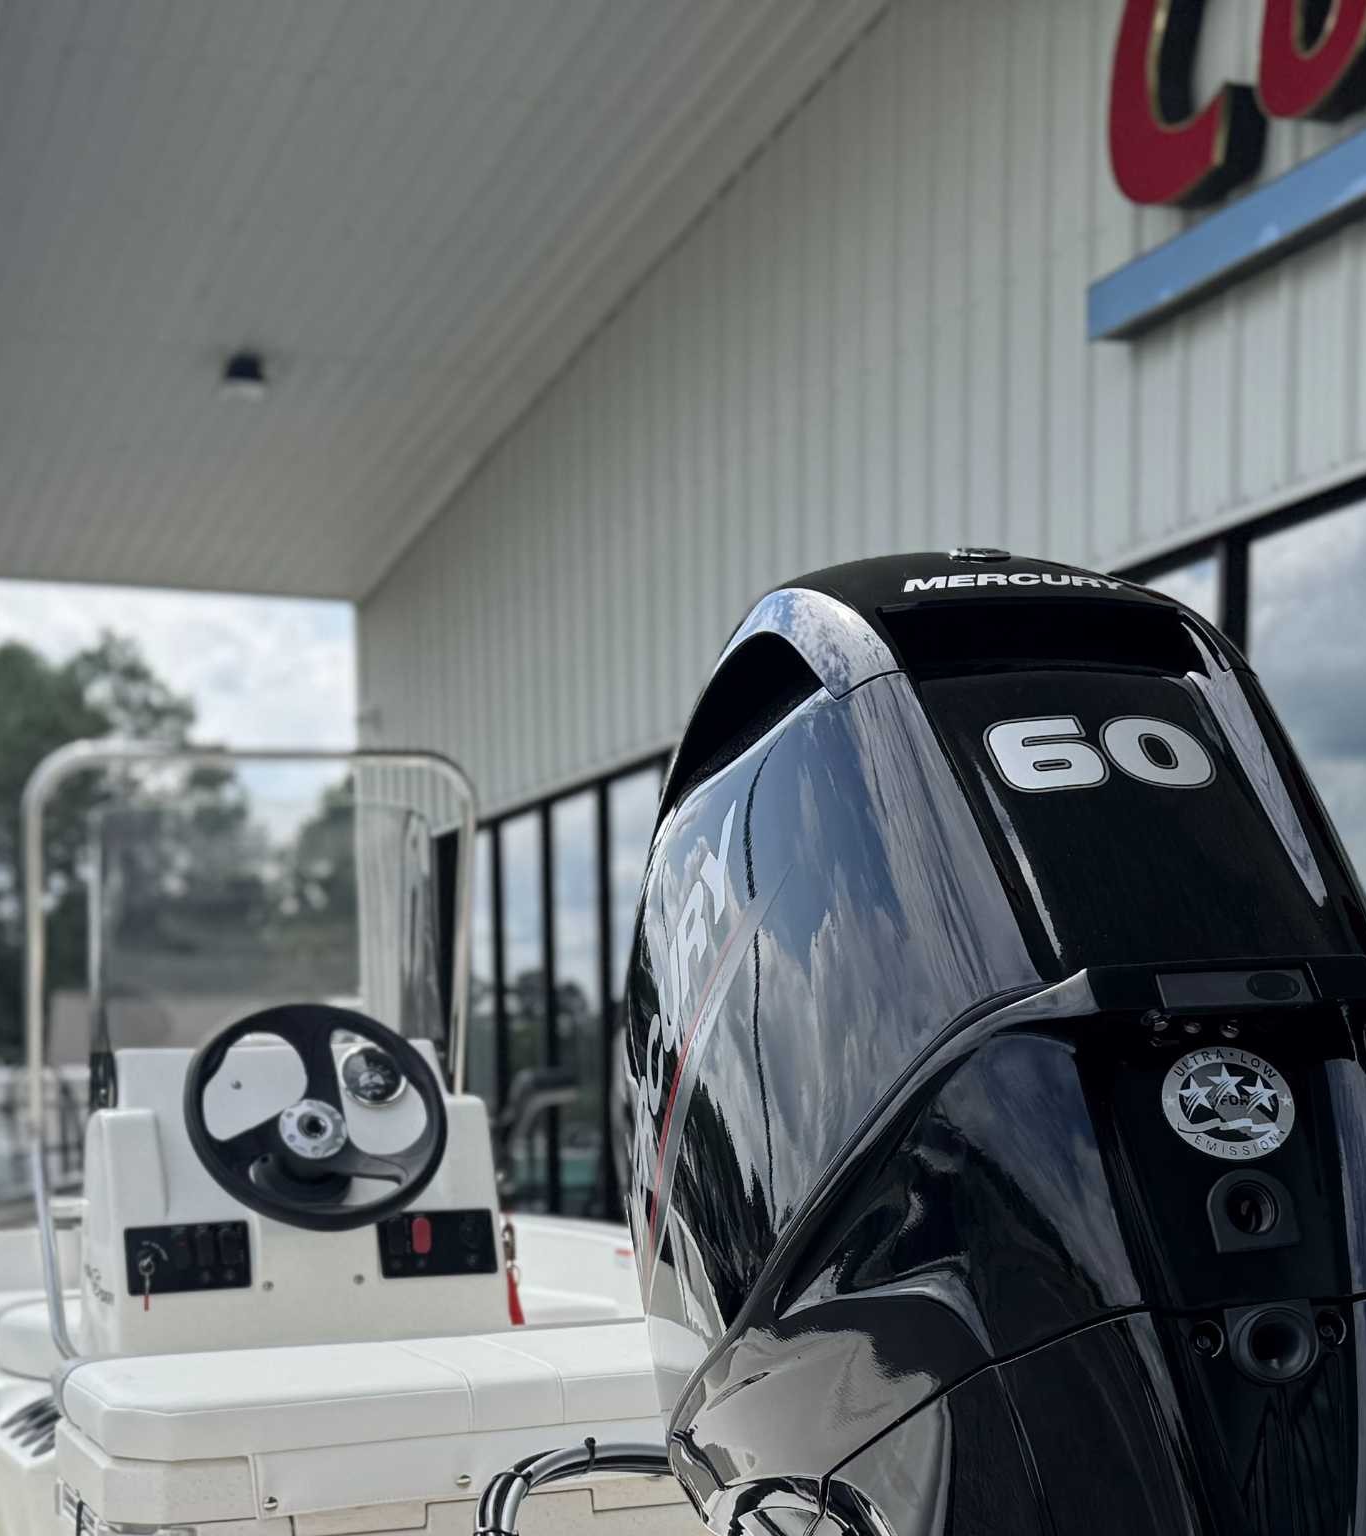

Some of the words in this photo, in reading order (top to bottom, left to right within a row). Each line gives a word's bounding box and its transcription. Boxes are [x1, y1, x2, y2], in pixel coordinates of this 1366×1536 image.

[903, 572, 1124, 592] MERCURY
[982, 714, 1217, 793] 60
[1173, 1049, 1225, 1078] ULTRA
[1240, 1051, 1280, 1080] LOW
[1194, 1133, 1281, 1157] EMISSION
